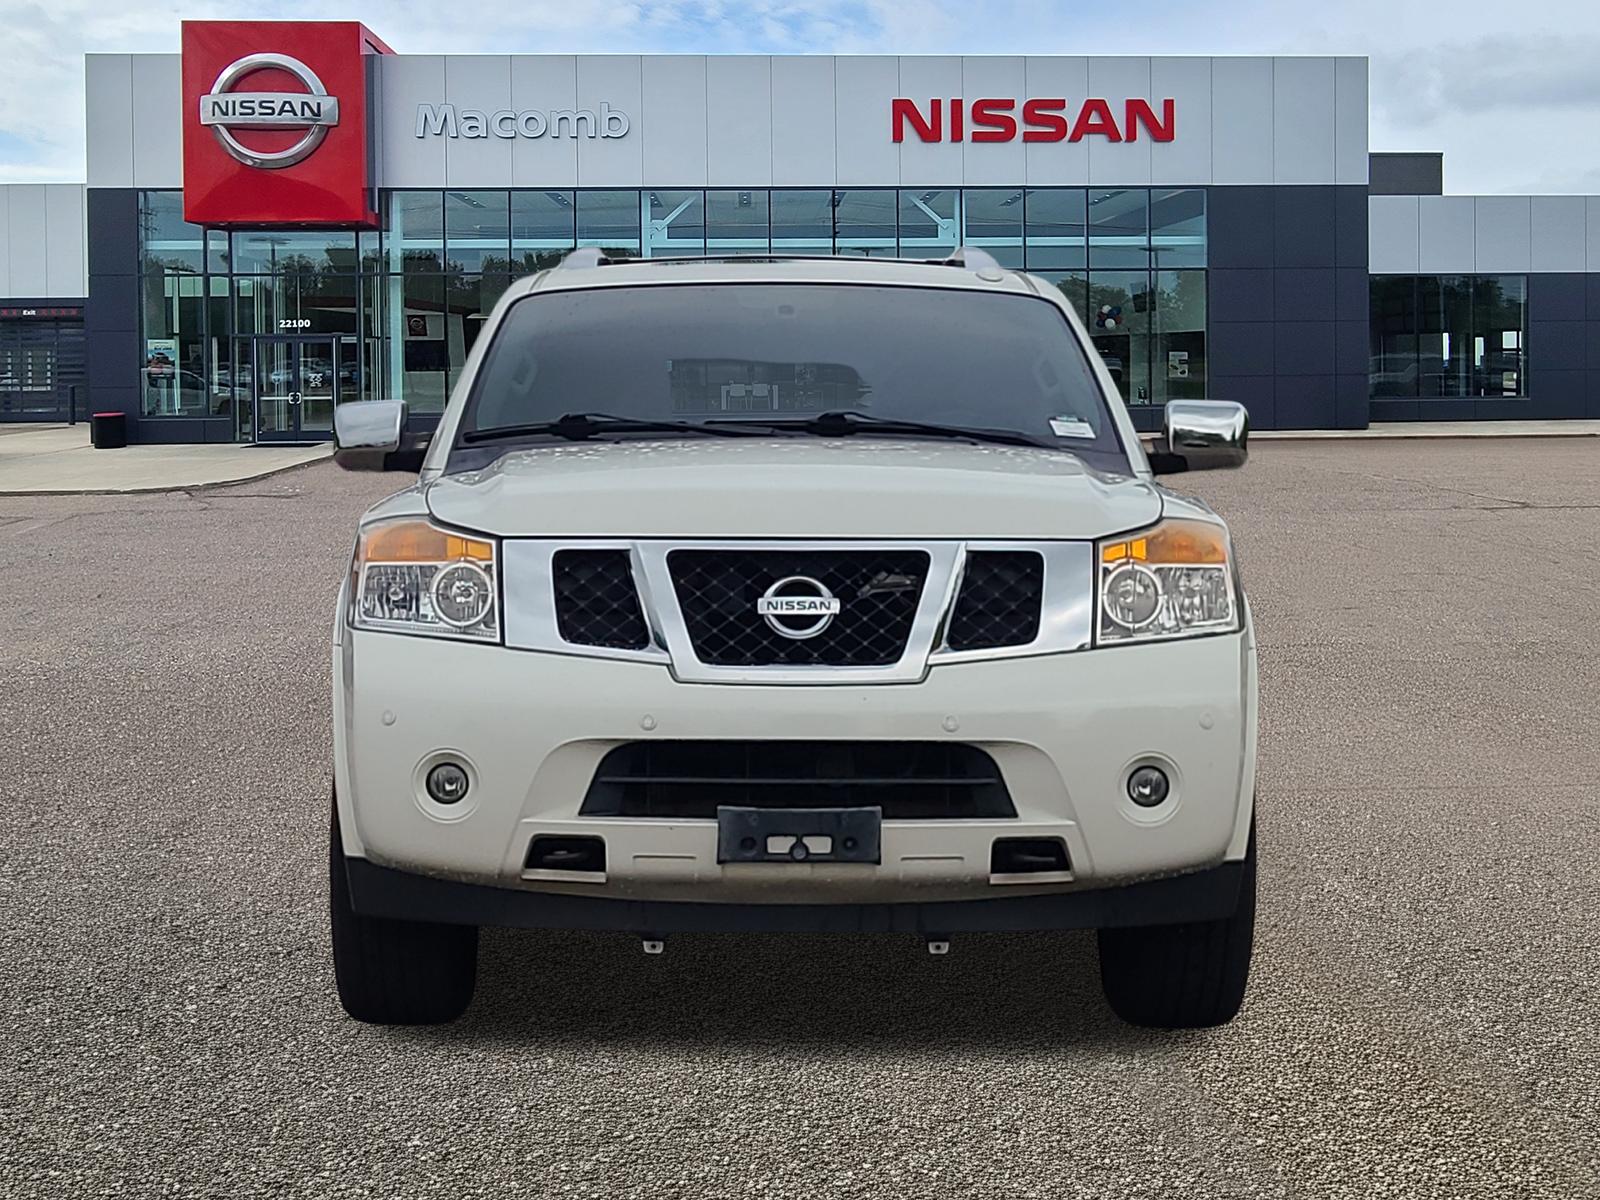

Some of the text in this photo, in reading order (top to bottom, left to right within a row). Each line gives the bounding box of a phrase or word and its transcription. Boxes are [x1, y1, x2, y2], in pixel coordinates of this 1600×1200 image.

[212, 100, 321, 117] NISSAN
[415, 102, 630, 139] Macomb
[892, 99, 1175, 143] NISSAN
[279, 319, 311, 328] 22100
[766, 601, 831, 611] NISSAN
